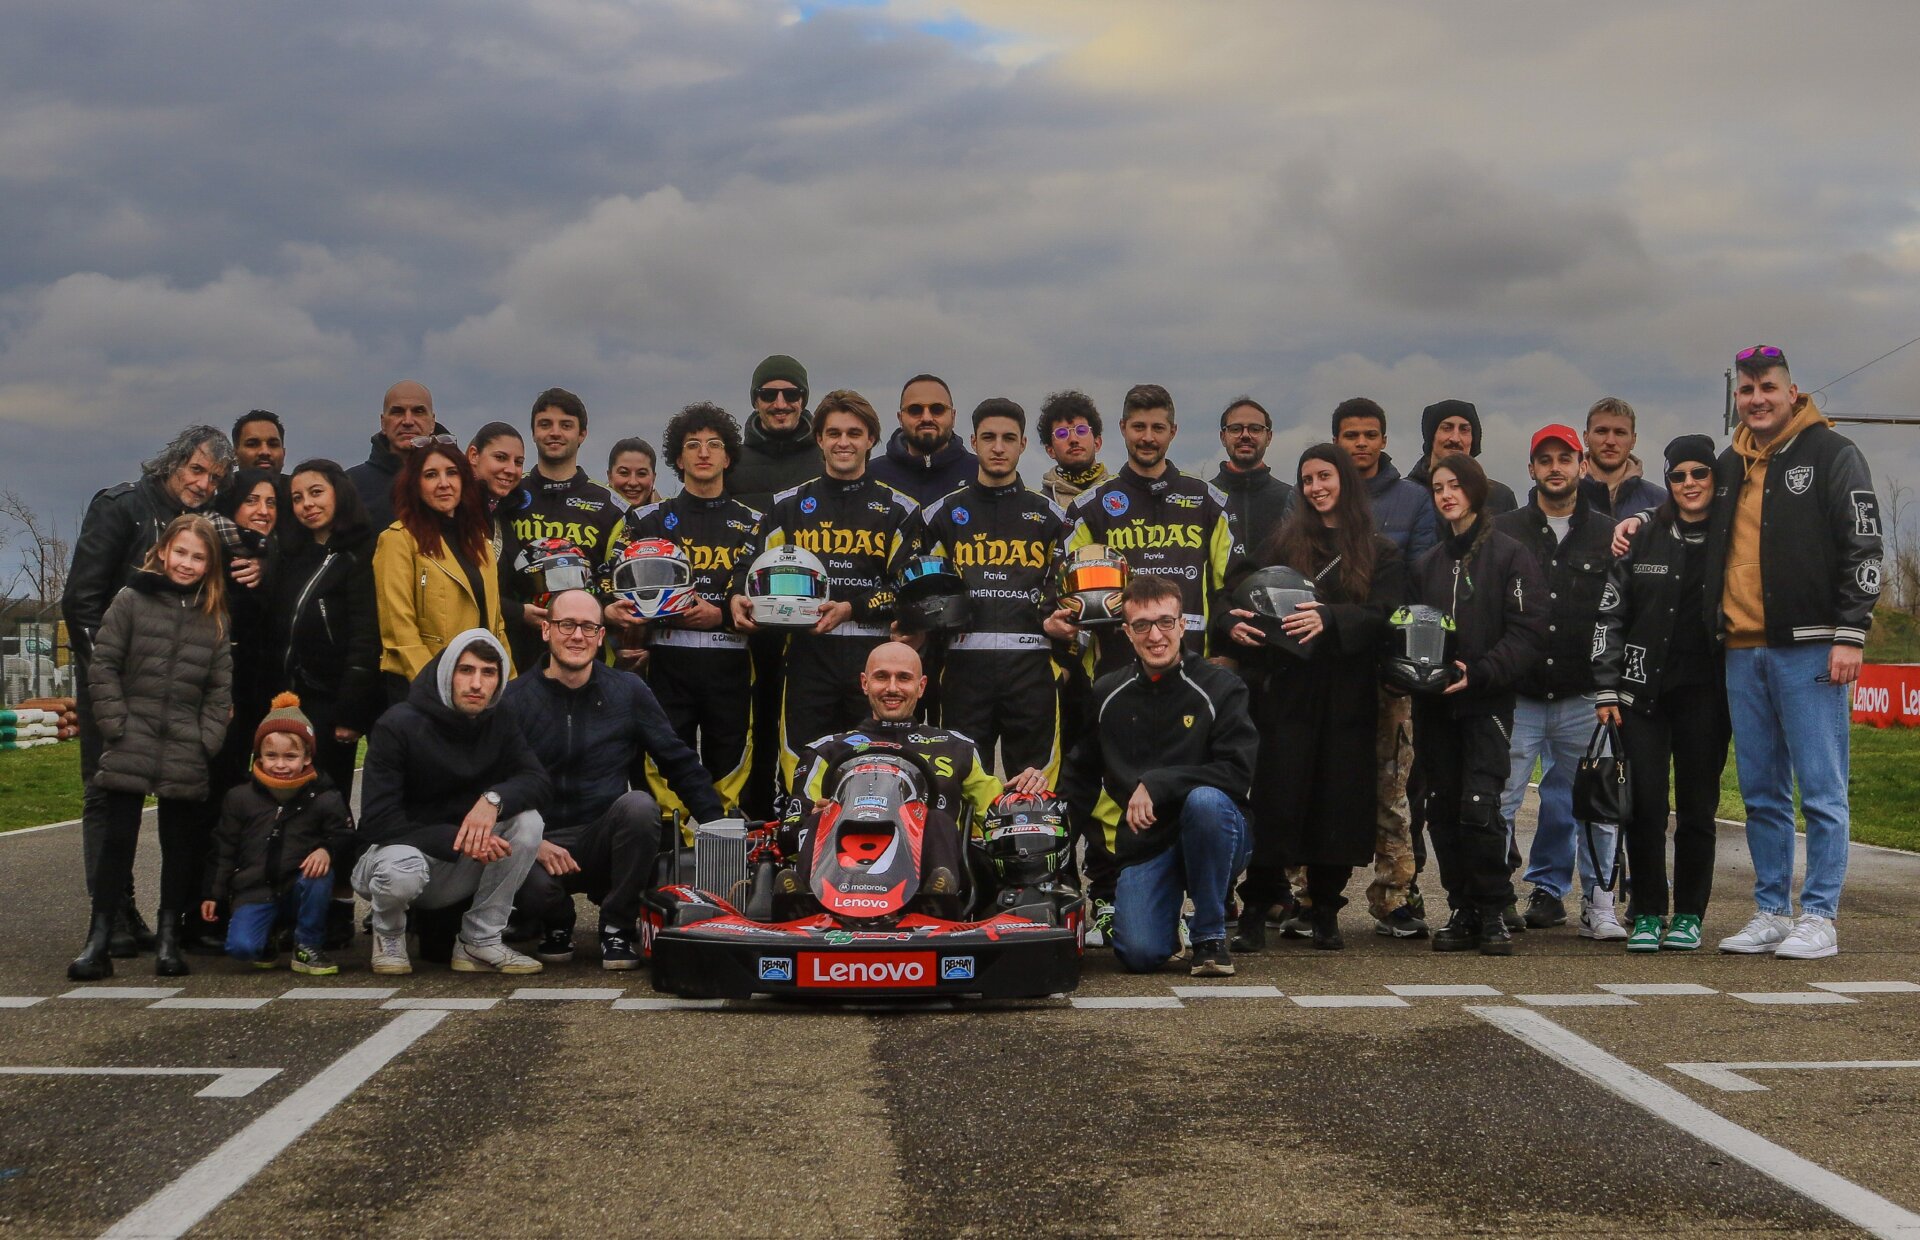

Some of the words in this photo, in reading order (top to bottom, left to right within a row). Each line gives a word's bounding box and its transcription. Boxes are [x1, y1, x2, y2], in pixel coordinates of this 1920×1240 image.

[1106, 518, 1203, 550] MIDAS
[794, 521, 885, 558] MIDAS
[829, 559, 853, 569] Pavia
[984, 571, 1007, 580] Pavia
[1131, 566, 1184, 575] MENTOCASA
[826, 578, 873, 587] ENTOCASA
[851, 884, 888, 892] motorola
[834, 897, 888, 908] Lenovo
[813, 958, 924, 982] Lenovo
